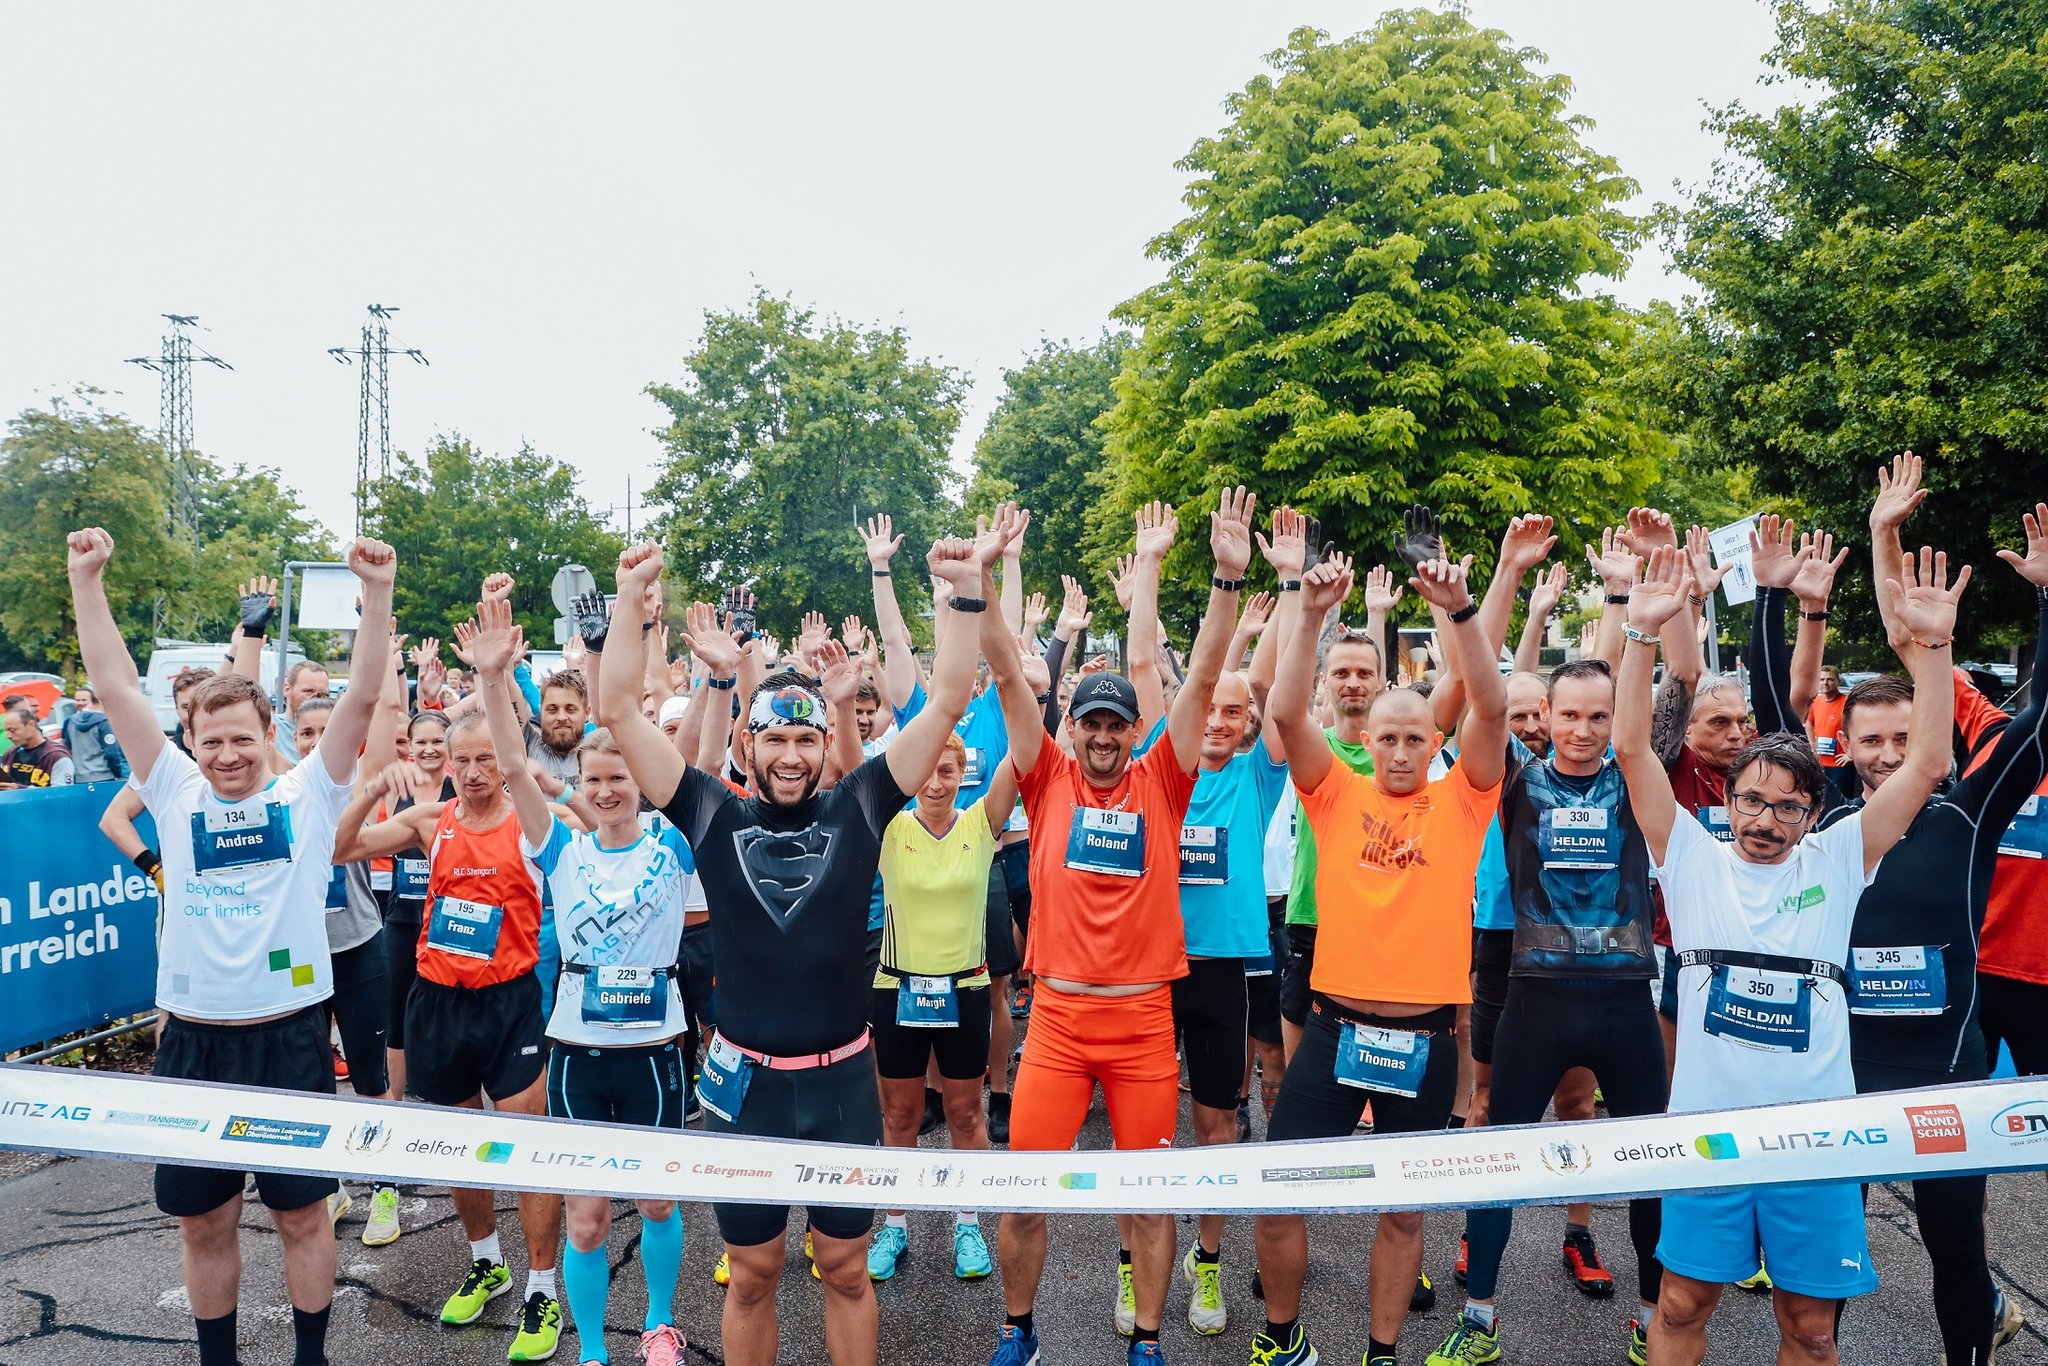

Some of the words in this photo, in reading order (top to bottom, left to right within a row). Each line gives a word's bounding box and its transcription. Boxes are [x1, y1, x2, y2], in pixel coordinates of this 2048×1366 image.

[224, 810, 246, 823] 134
[1101, 813, 1119, 826] 181
[1570, 811, 1589, 822] 330
[1183, 829, 1196, 839] 13
[1712, 831, 1736, 839] HEL
[216, 834, 264, 849] Andras
[1086, 833, 1128, 851] Roland
[1553, 836, 1606, 847] HELD/IN
[1179, 850, 1216, 864] lfgang
[186, 879, 246, 899] beyond
[184, 904, 210, 916] our
[216, 903, 262, 918] limits
[458, 902, 474, 914] 195
[448, 920, 476, 936] Franz
[0, 913, 118, 974] rreich
[1876, 951, 1900, 963] 345
[617, 970, 637, 980] 229
[922, 980, 933, 988] 76
[1748, 980, 1774, 996] 350
[1860, 980, 1926, 990] HELD/IN
[600, 992, 651, 1004] Gabriele
[916, 996, 946, 1010] Margit
[1725, 1002, 1793, 1026] HELD/IN
[1378, 1030, 1390, 1042] 71
[1358, 1049, 1406, 1070] Thomas
[1, 1101, 48, 1118] INZ
[50, 1105, 92, 1121] AG
[148, 1115, 198, 1127] TANNPAPIER
[1912, 1114, 1958, 1127] RUND
[246, 1130, 294, 1140] Oberösterreich
[248, 1124, 280, 1133] Raiffeisen
[281, 1127, 320, 1137] Landesbank
[1917, 1128, 1961, 1138] SCHAU
[1758, 1132, 1834, 1151] LINZ
[1842, 1128, 1888, 1146] AG
[405, 1139, 468, 1157] delfort
[1614, 1141, 1686, 1162] delfort
[531, 1151, 596, 1168] LINZ
[600, 1157, 642, 1171] AG
[817, 1168, 898, 1187] TRAUN
[1404, 1168, 1455, 1180] HEIZUNG
[1459, 1166, 1482, 1176] BAD
[1486, 1163, 1521, 1173] GMBH
[981, 1175, 1048, 1187] delfort
[1120, 1176, 1188, 1186] LINZ
[1196, 1174, 1238, 1186] AG
